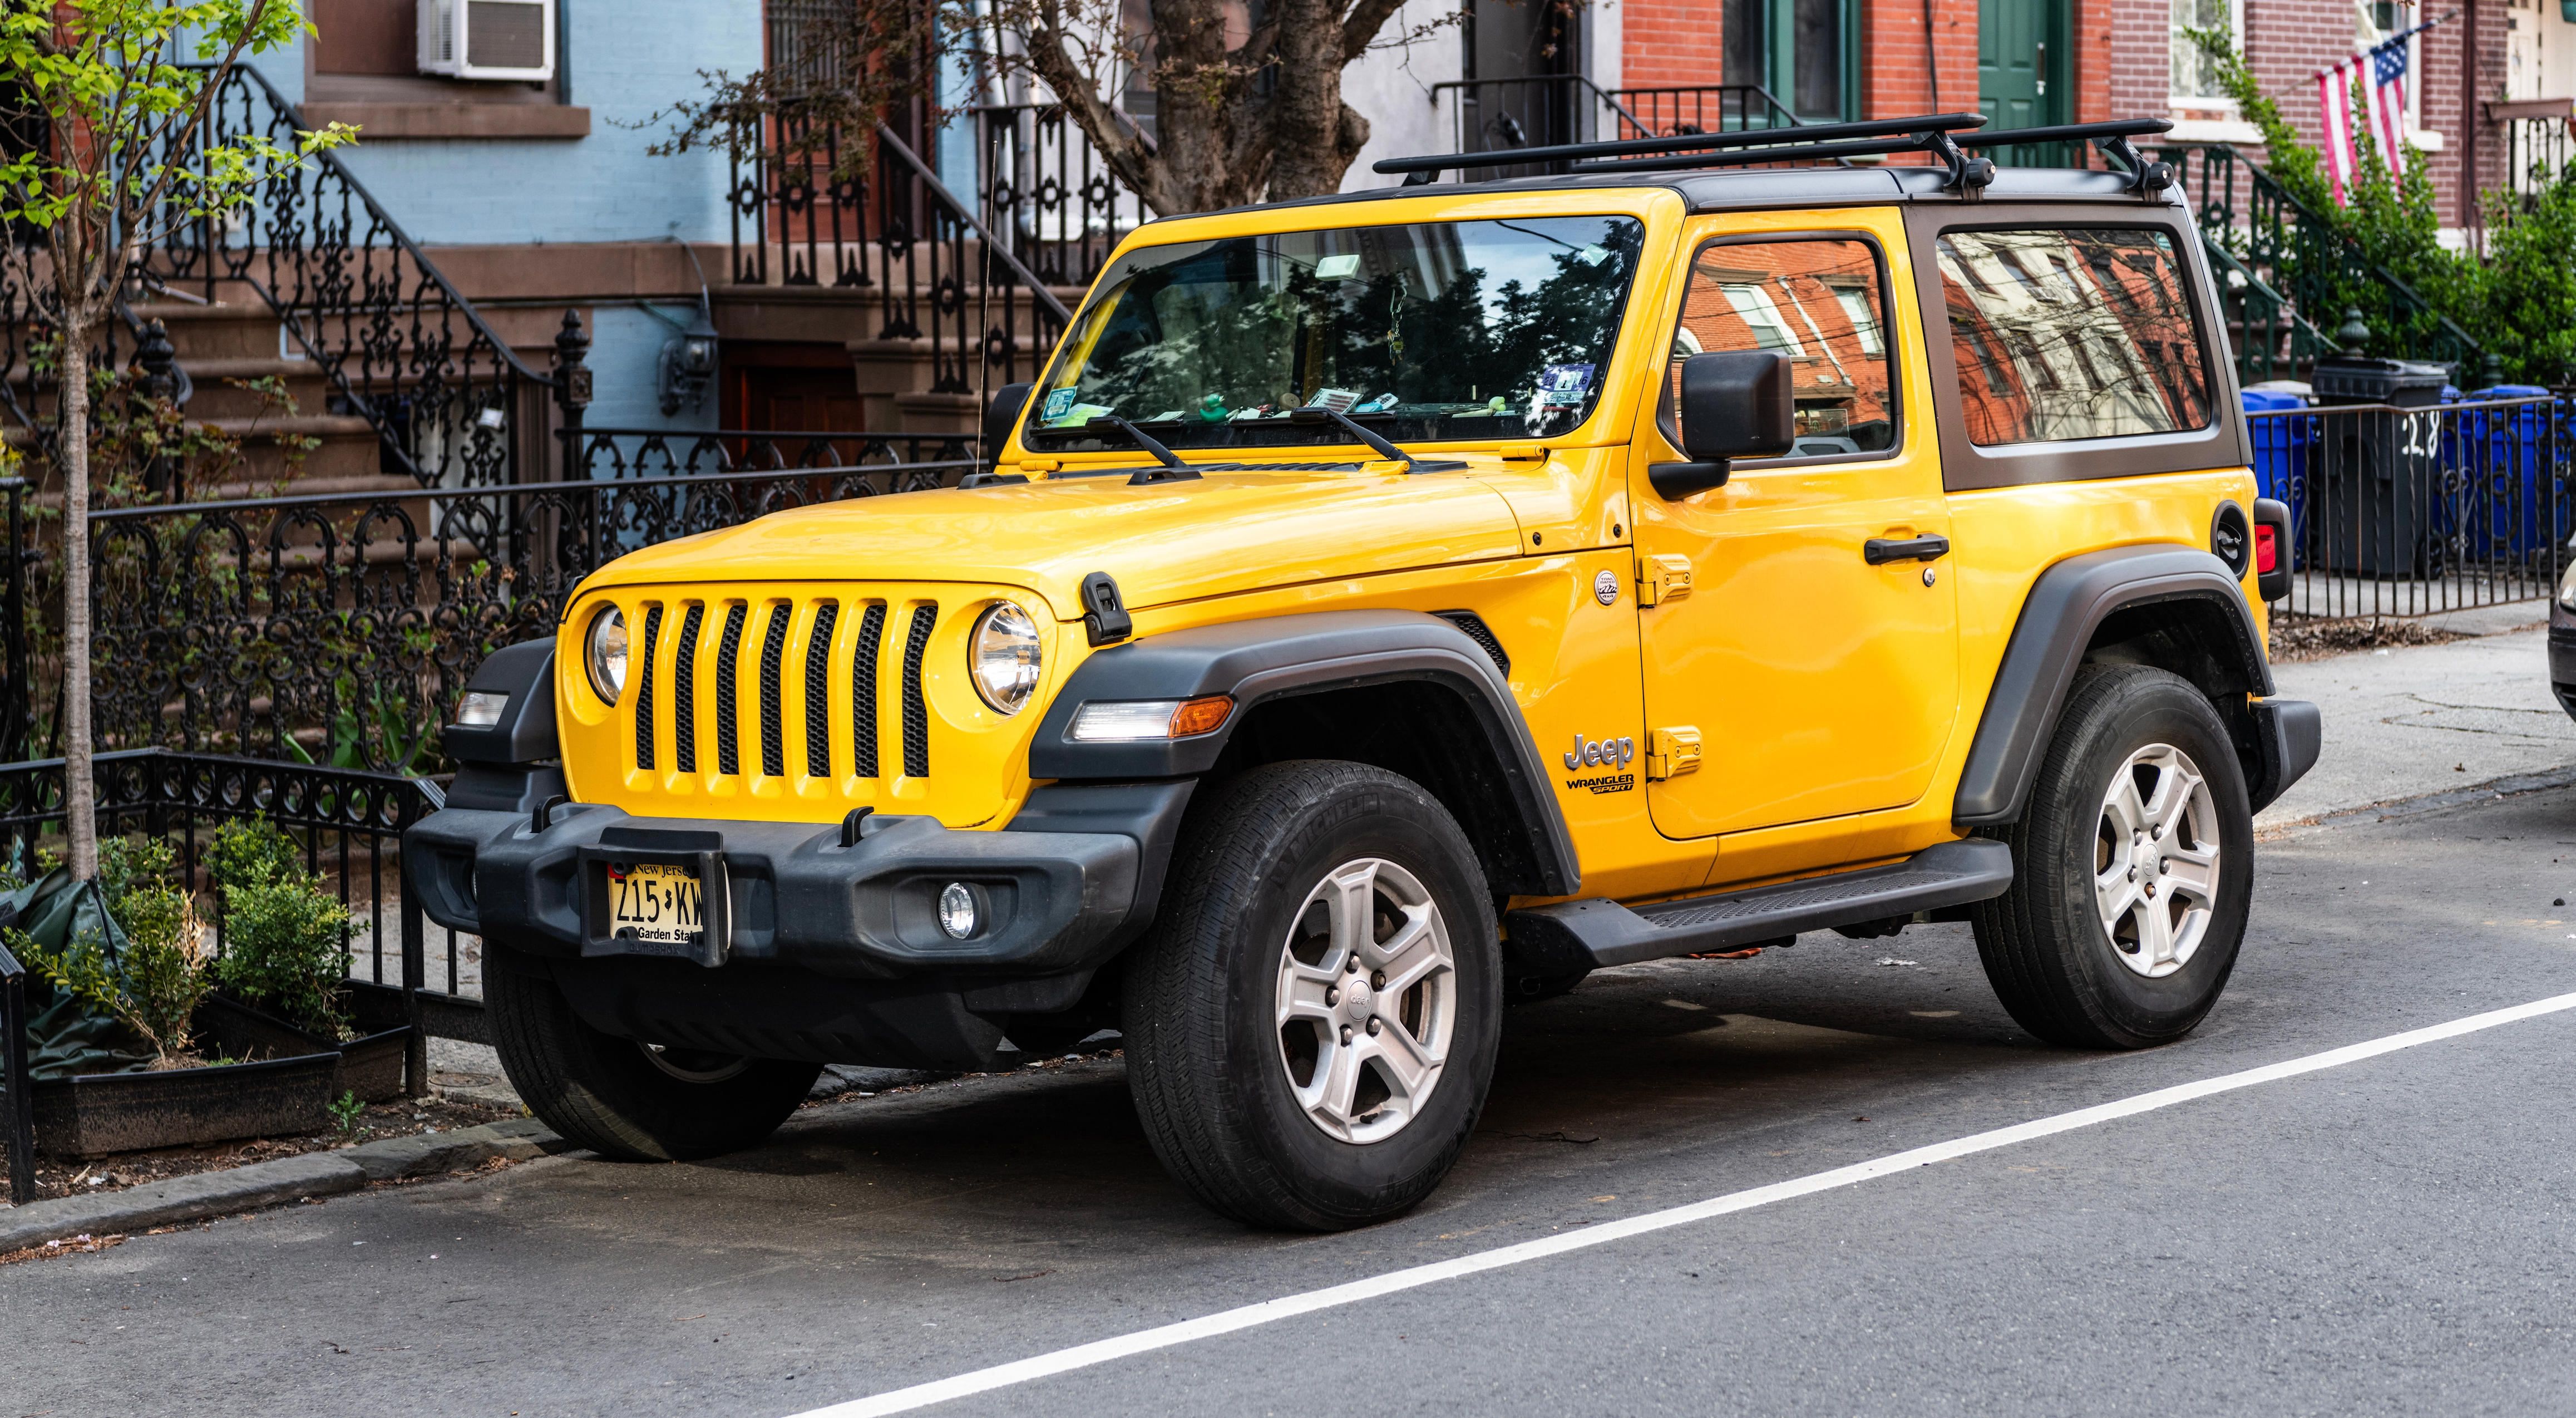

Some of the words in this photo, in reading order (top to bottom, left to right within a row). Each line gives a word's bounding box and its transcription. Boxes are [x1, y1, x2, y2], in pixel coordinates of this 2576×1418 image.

[2402, 410, 2440, 459] 28
[1564, 733, 1634, 770] Jeep
[1566, 774, 1634, 789] WRANGLER
[1592, 784, 1632, 793] SPORT
[634, 864, 659, 874] New
[615, 878, 659, 922] Z15
[638, 927, 670, 939] Garden
[674, 929, 693, 941] Sta
